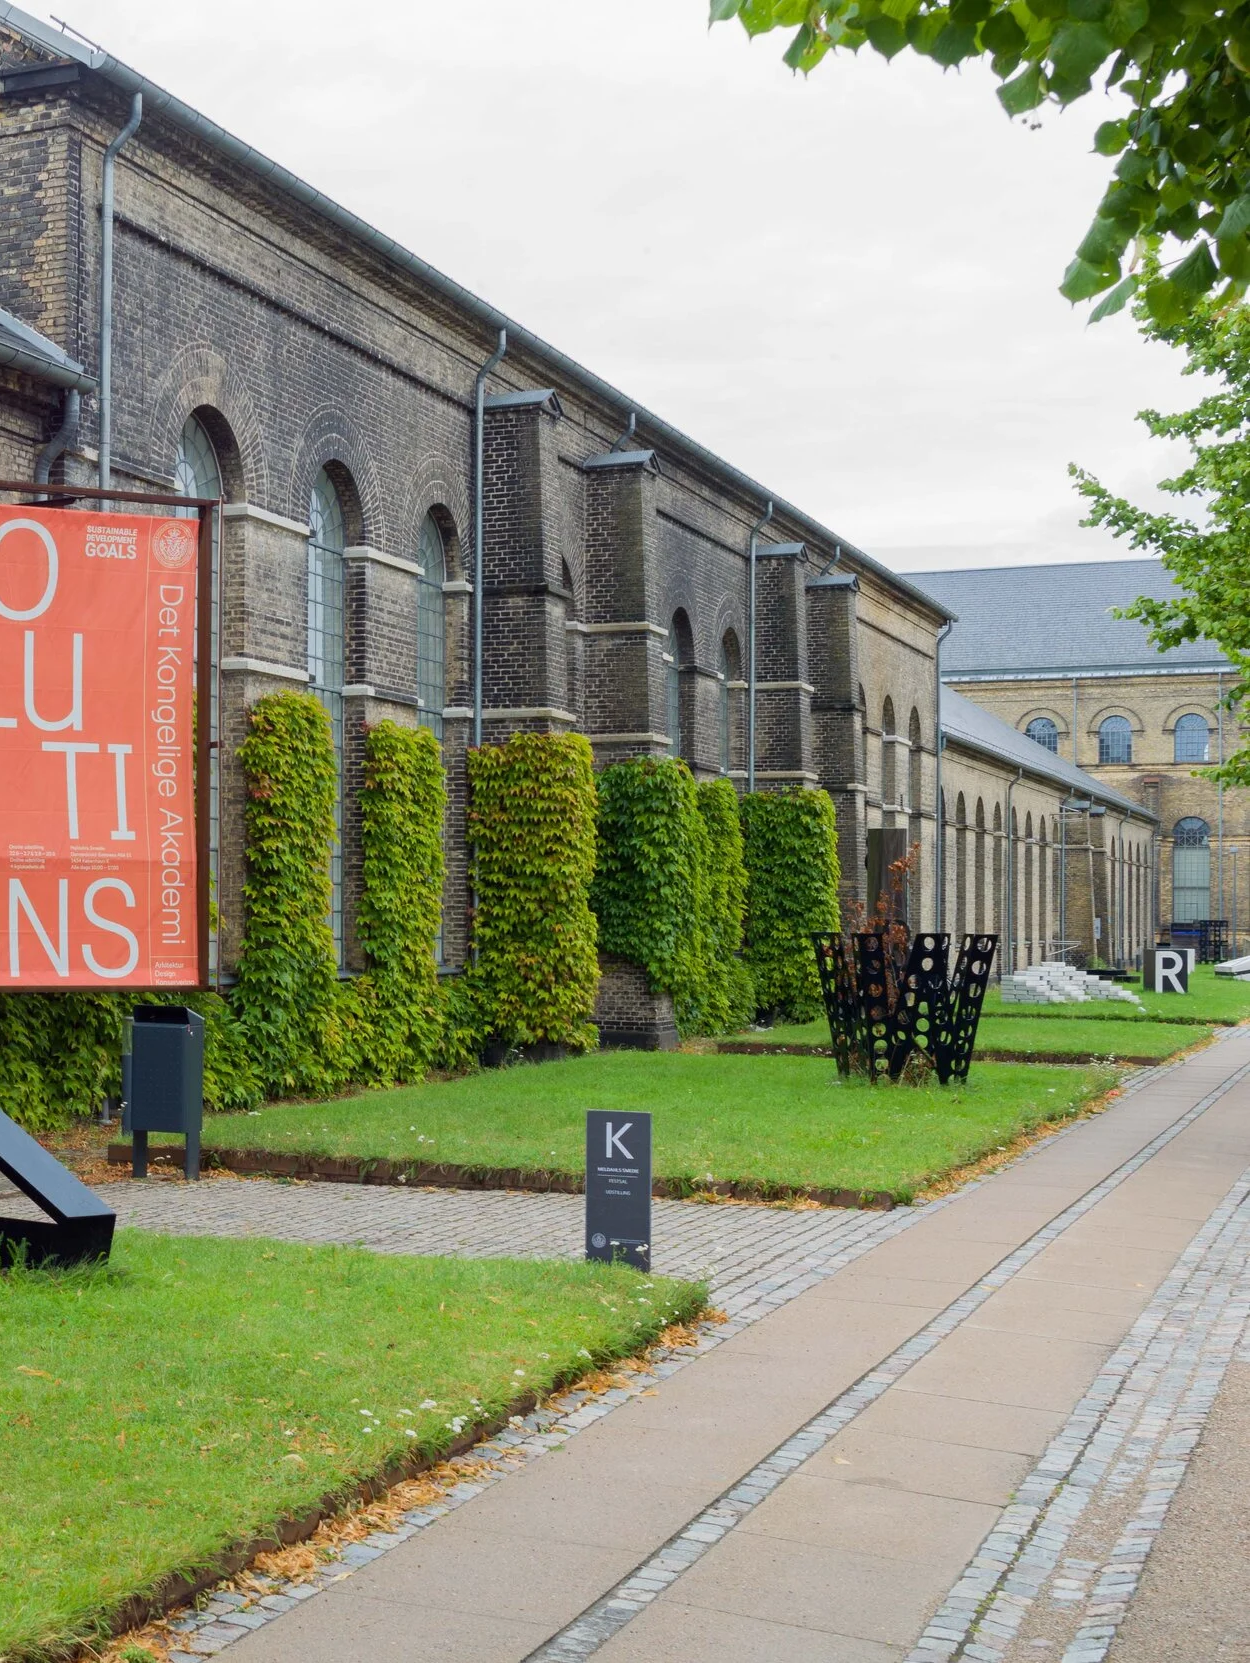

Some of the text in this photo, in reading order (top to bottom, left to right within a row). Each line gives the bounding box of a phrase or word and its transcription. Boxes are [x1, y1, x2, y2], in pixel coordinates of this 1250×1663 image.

[86, 533, 137, 544] DEVELOPMENT
[87, 525, 138, 536] SUSTAINABLE
[85, 542, 137, 559] GOALS
[158, 584, 184, 638] Det
[151, 647, 182, 798] Kongelige
[41, 741, 136, 841] TI
[159, 808, 185, 945] Akademi
[155, 961, 184, 969] Arkitektur
[155, 970, 176, 979] Design
[1155, 950, 1186, 994] R
[605, 1121, 634, 1160] K
